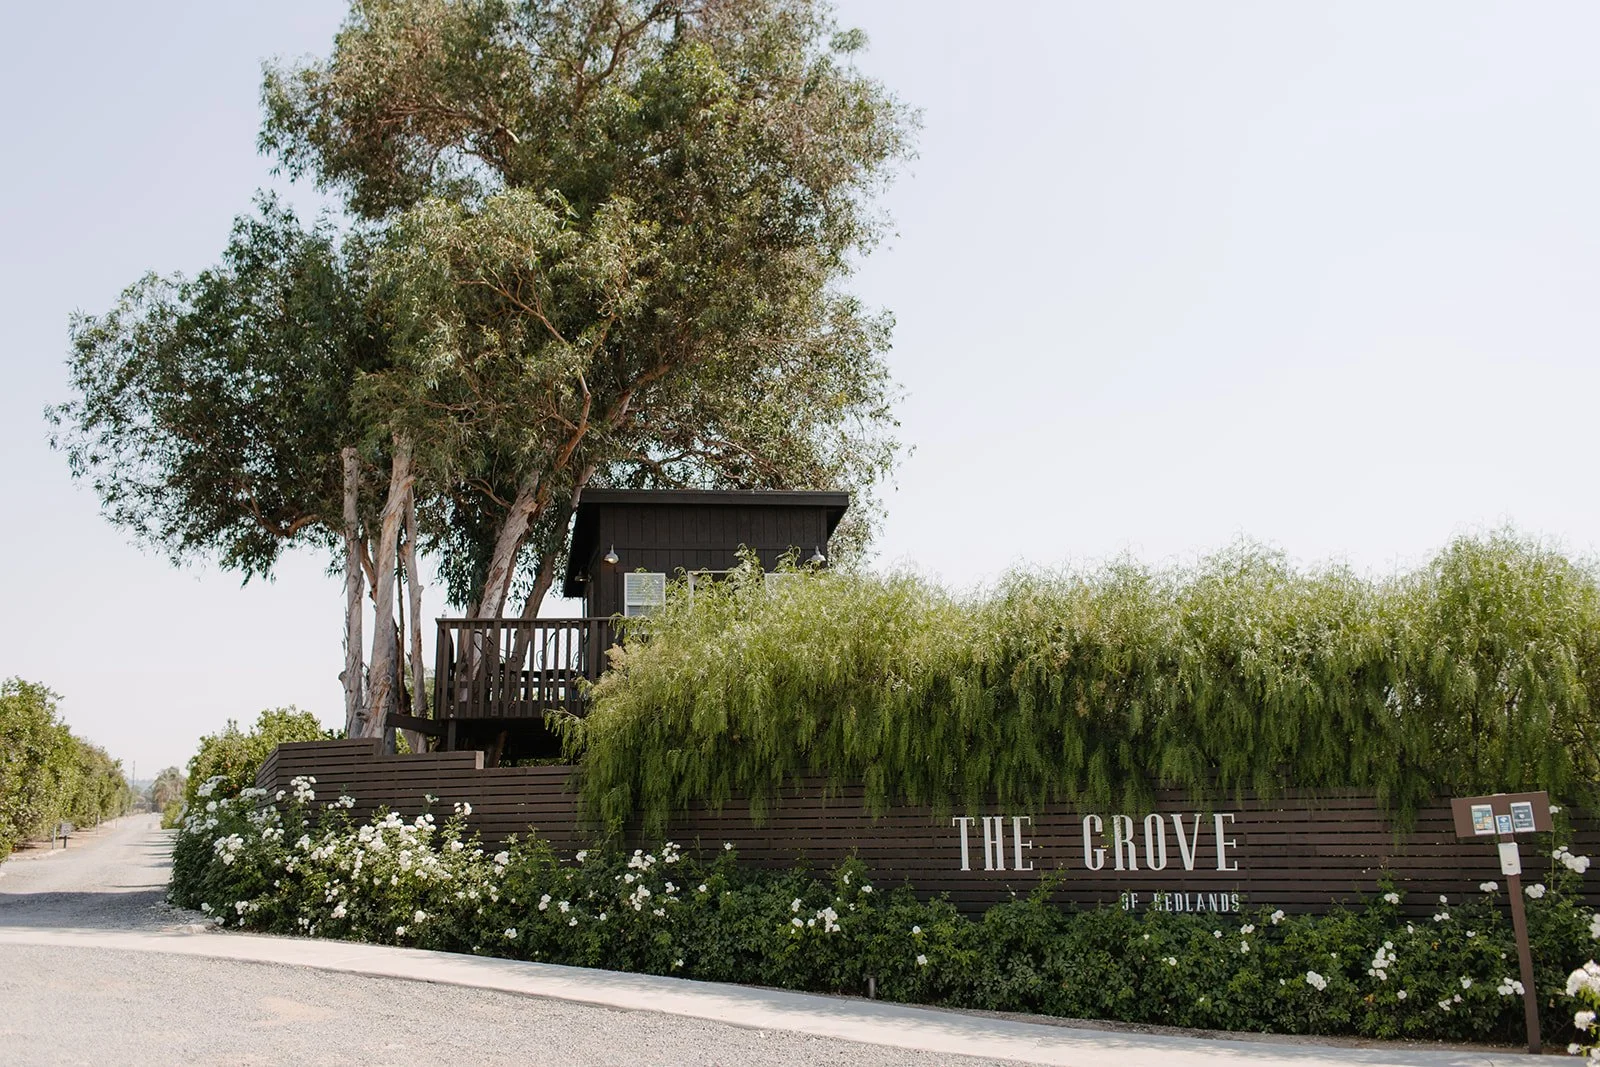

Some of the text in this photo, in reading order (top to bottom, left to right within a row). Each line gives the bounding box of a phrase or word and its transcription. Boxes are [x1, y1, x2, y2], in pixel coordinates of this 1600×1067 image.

[952, 813, 1239, 871] THE GROVE
[1121, 892, 1138, 911] OF
